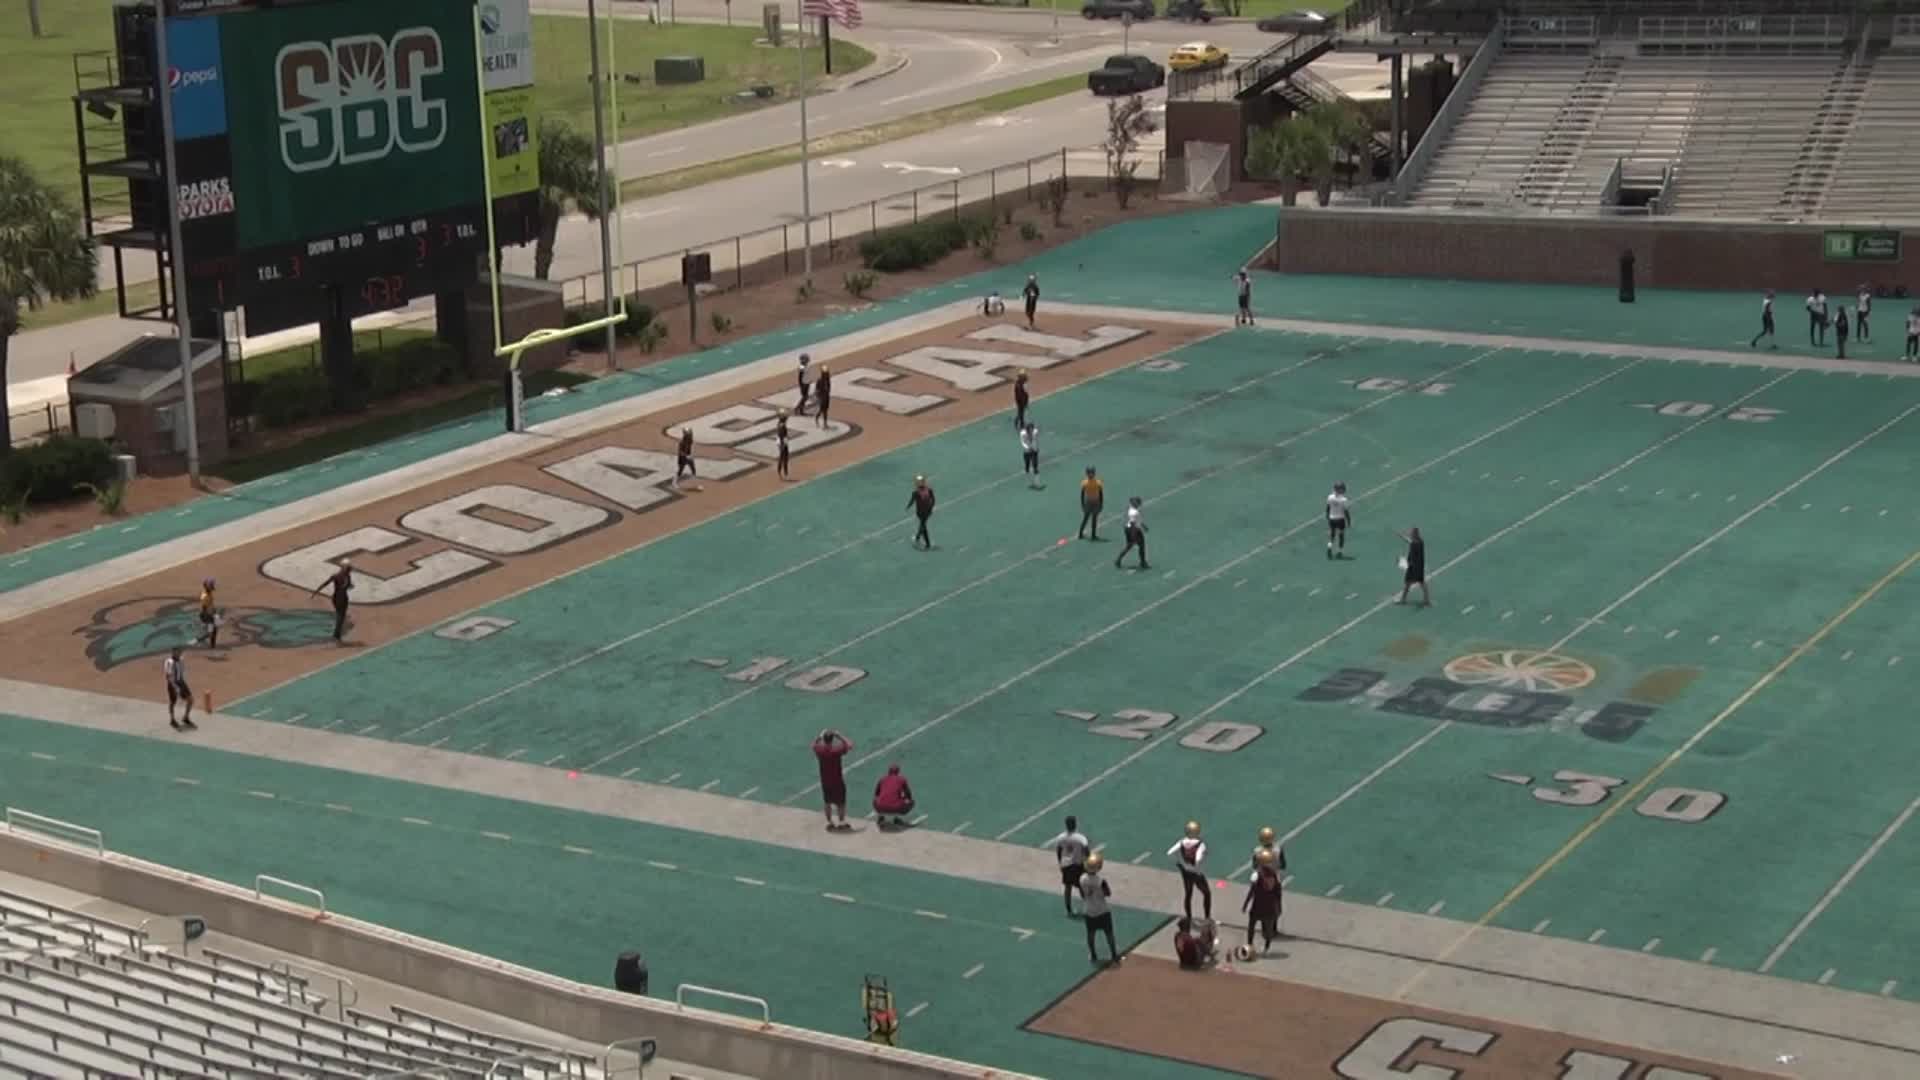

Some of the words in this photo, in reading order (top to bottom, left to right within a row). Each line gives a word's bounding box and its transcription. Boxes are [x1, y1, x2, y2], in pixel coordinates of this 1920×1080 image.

[182, 66, 218, 88] pepsi
[483, 53, 517, 72] HEALTH
[275, 26, 447, 173] SBC
[178, 191, 235, 221] OYOTA
[307, 239, 335, 256] DOWN
[259, 323, 1154, 606] COASTAL
[1087, 708, 1267, 752] 20
[1531, 769, 1729, 823] 30
